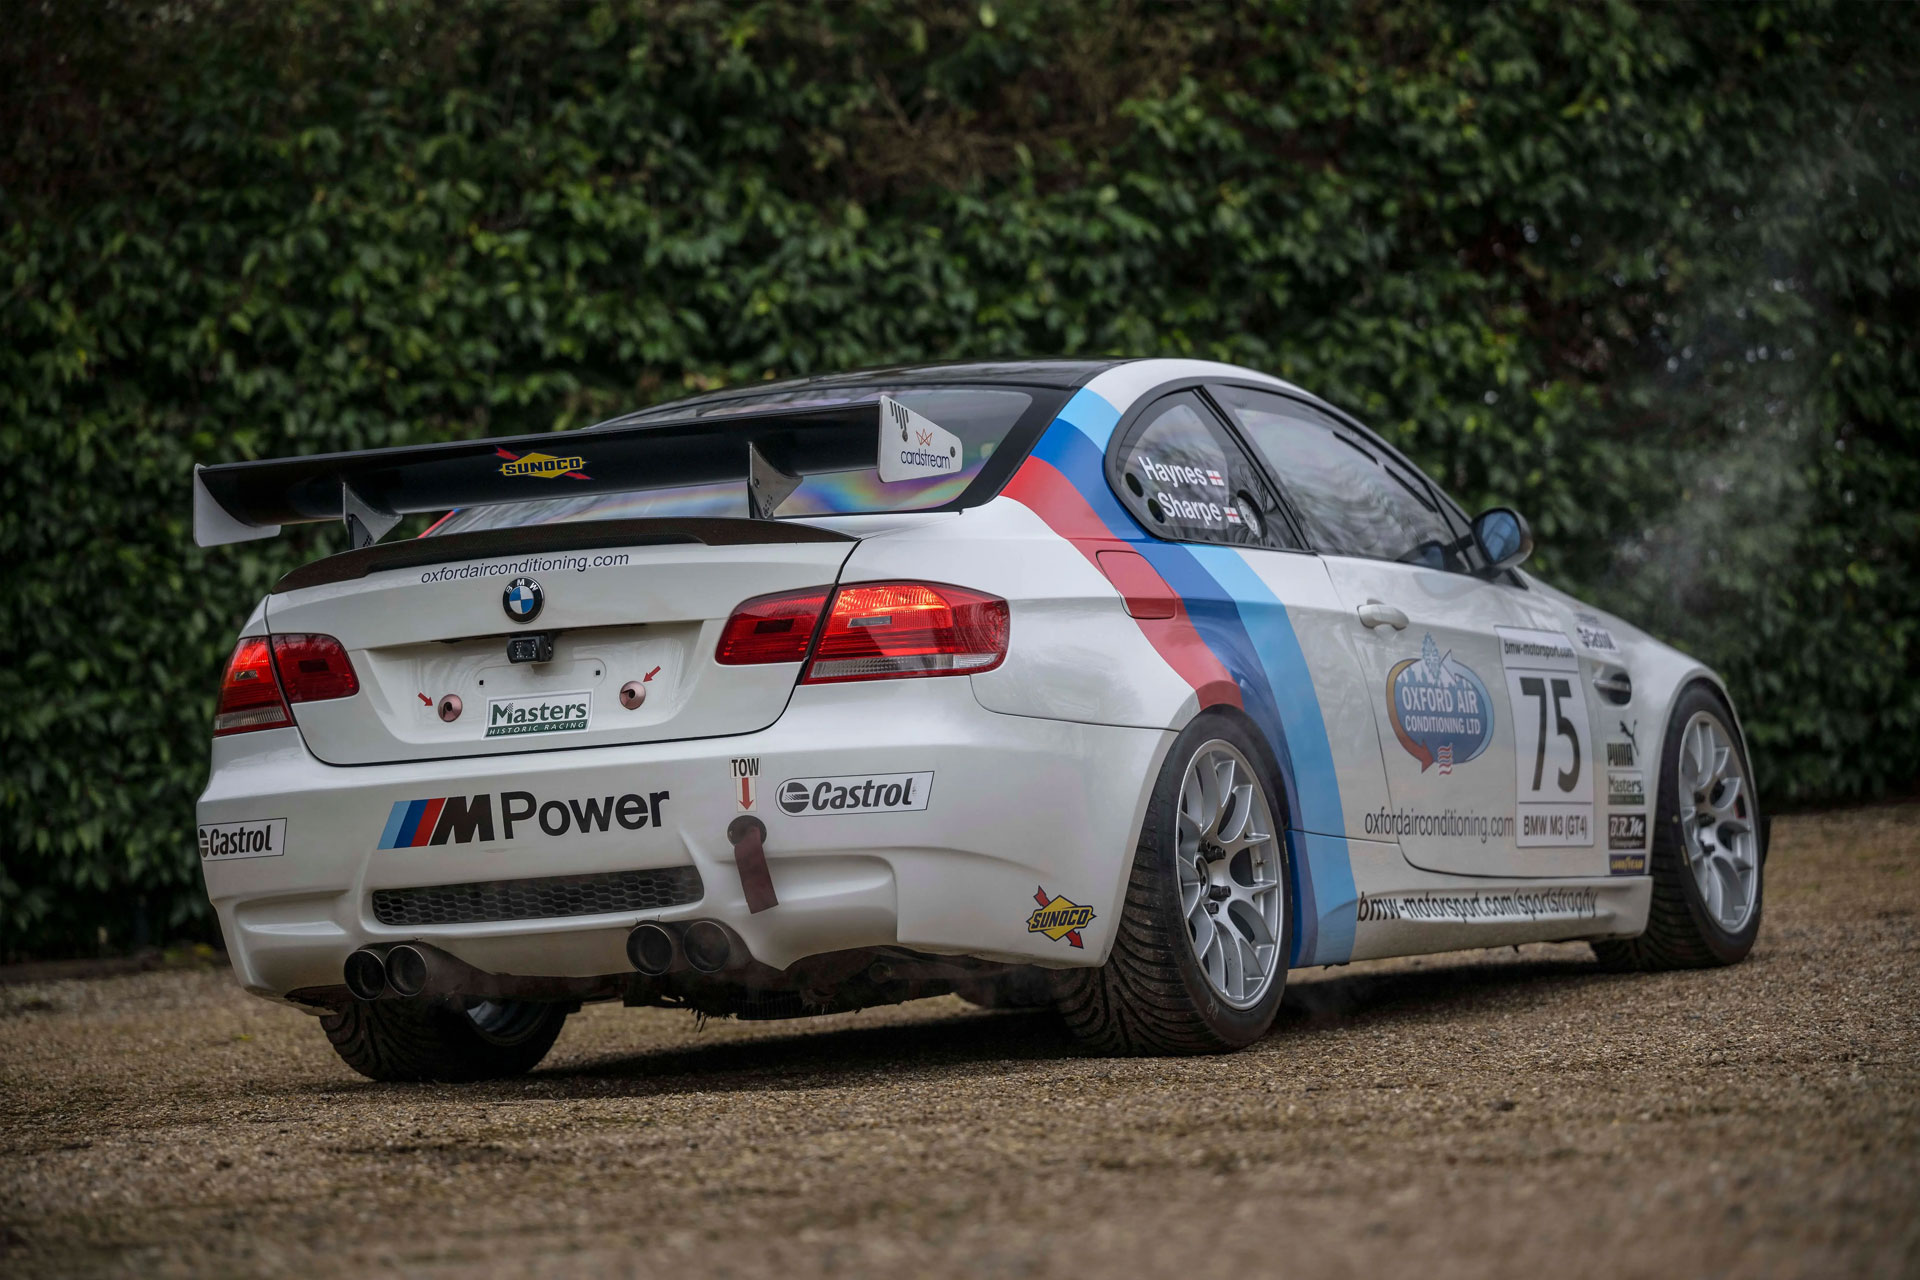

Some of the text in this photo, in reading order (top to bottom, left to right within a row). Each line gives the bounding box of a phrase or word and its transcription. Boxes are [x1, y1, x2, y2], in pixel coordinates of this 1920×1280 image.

[504, 456, 582, 476] SUNOCO
[900, 448, 950, 469] cardstream
[1138, 456, 1206, 488] Haynes
[1158, 490, 1222, 524] Sharpe
[421, 553, 629, 583] oxfordairconditioning.com
[506, 578, 539, 593] BMW
[1402, 686, 1479, 714] OXFORD AIR
[492, 702, 587, 726] Masters
[1405, 715, 1480, 735] CONDITIONING LTD
[489, 720, 585, 736] HISTORIC RACING
[1519, 676, 1581, 793] 75
[731, 757, 759, 777] TOW
[812, 777, 912, 811] Castrol
[1608, 774, 1642, 793] Masters
[500, 790, 670, 840] Power
[1364, 806, 1515, 844] oxfordairconditioning.com
[1523, 816, 1588, 840] BMW M3 (GT4)
[209, 824, 272, 856] Castrol
[1356, 886, 1598, 924] bmw-motorsport.com/sportstrophy
[1029, 909, 1090, 930] SUNOCO
